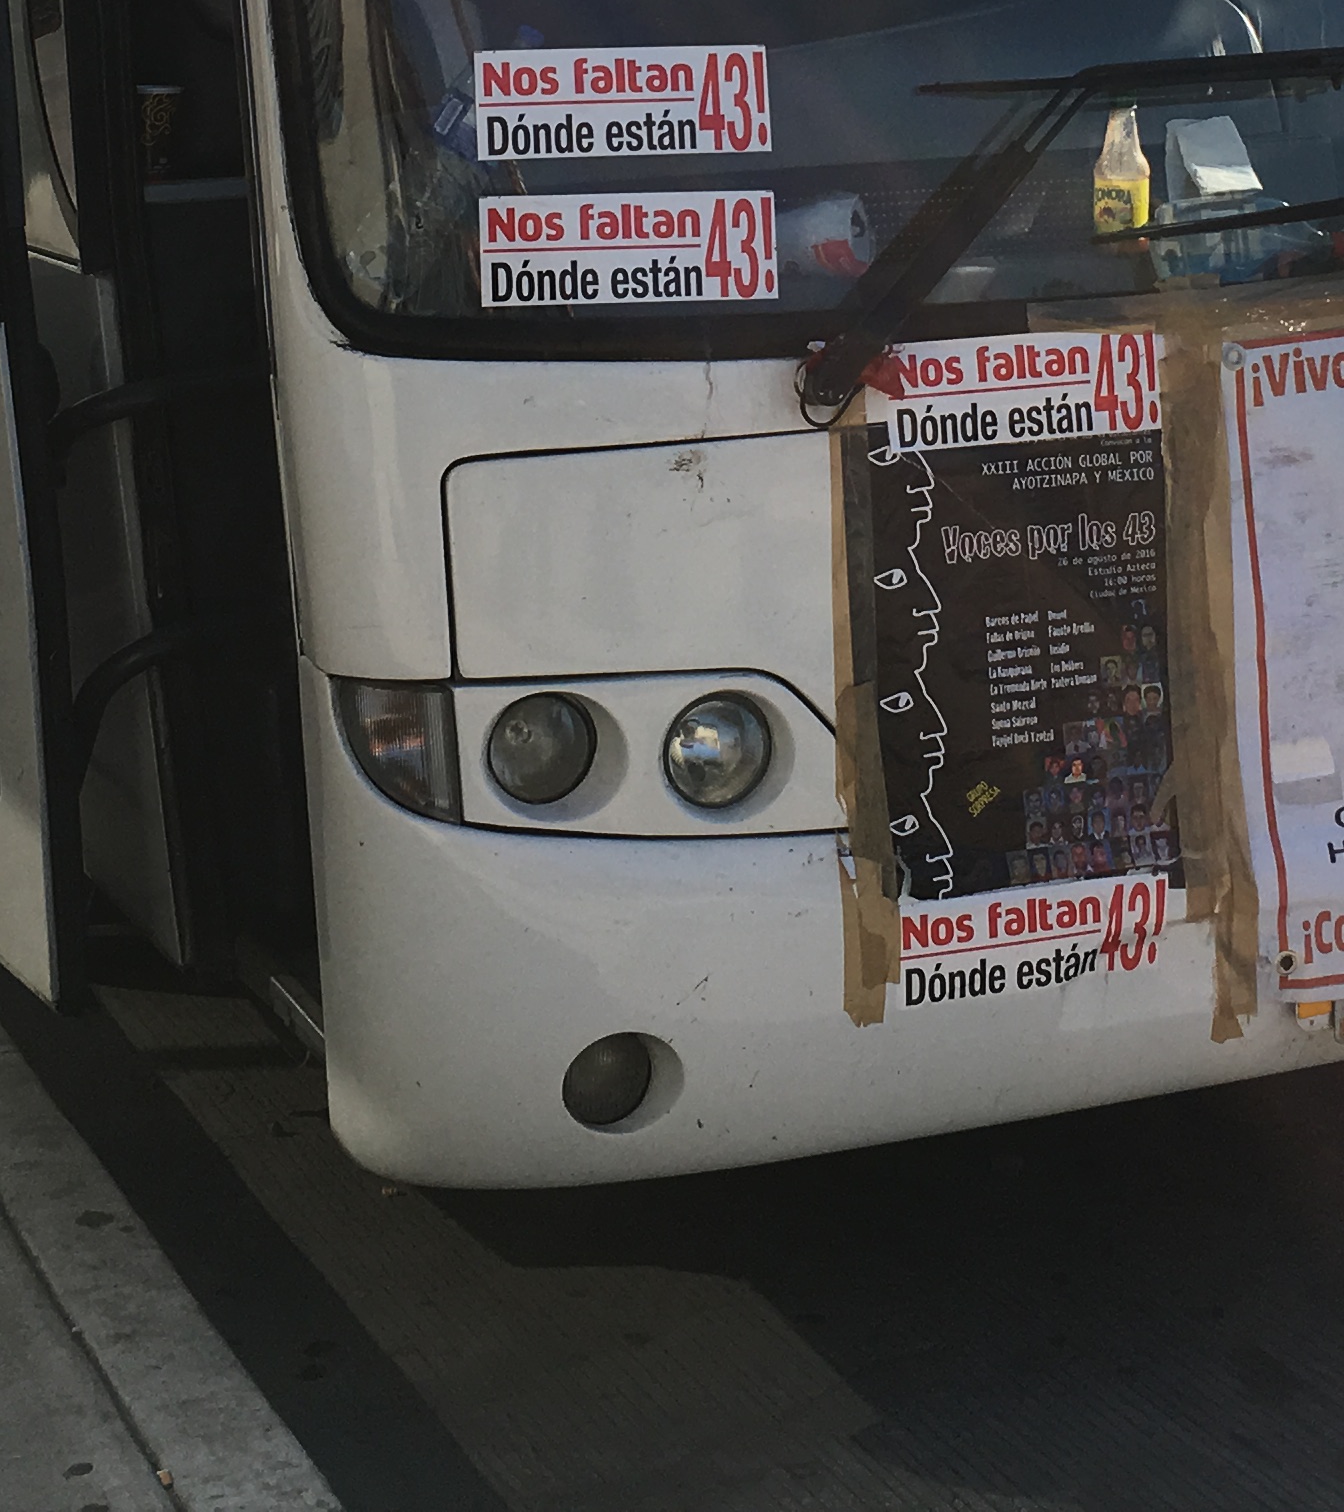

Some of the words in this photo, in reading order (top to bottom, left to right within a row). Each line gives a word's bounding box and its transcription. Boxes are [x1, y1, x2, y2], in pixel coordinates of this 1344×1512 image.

[483, 62, 559, 97] Nos
[574, 57, 694, 94] faltan
[698, 51, 768, 152] 43!
[487, 113, 594, 156] Dónde
[605, 109, 697, 152] están
[487, 208, 565, 243] Nos
[580, 204, 701, 240] faltan
[705, 196, 775, 299] 43!
[491, 260, 599, 303] Dónde
[610, 256, 703, 299] están
[896, 353, 964, 388] Nos
[976, 344, 1091, 383] faltan
[1094, 329, 1159, 431] 43!
[896, 403, 998, 449] Dónde
[1008, 393, 1094, 438] están
[982, 460, 1019, 476] XXIII
[1026, 453, 1072, 472] ACCIÓN
[1079, 453, 1122, 468] GLOBAL
[1130, 450, 1153, 464] POR
[1012, 471, 1088, 490] AYOTZINAPA
[1094, 471, 1102, 484] Y
[1108, 466, 1154, 482] MÉXICO
[941, 524, 1022, 564] Voces
[1027, 523, 1072, 560] por
[1078, 513, 1116, 551] los
[1123, 511, 1156, 546] 43
[1057, 557, 1068, 567] 26
[1072, 556, 1083, 565] de
[1121, 552, 1131, 561] de
[1136, 550, 1156, 560] 2016
[1126, 562, 1156, 572] Azteca
[1132, 574, 1156, 583] horas
[1011, 613, 1020, 625] de
[966, 780, 989, 803] GRUPO
[968, 785, 1001, 818] SORPRESA
[902, 913, 975, 950] Nos
[988, 896, 1101, 939] faltan
[1100, 878, 1167, 972] 43!
[905, 958, 1006, 1007] Dónde
[1016, 943, 1099, 990] están
